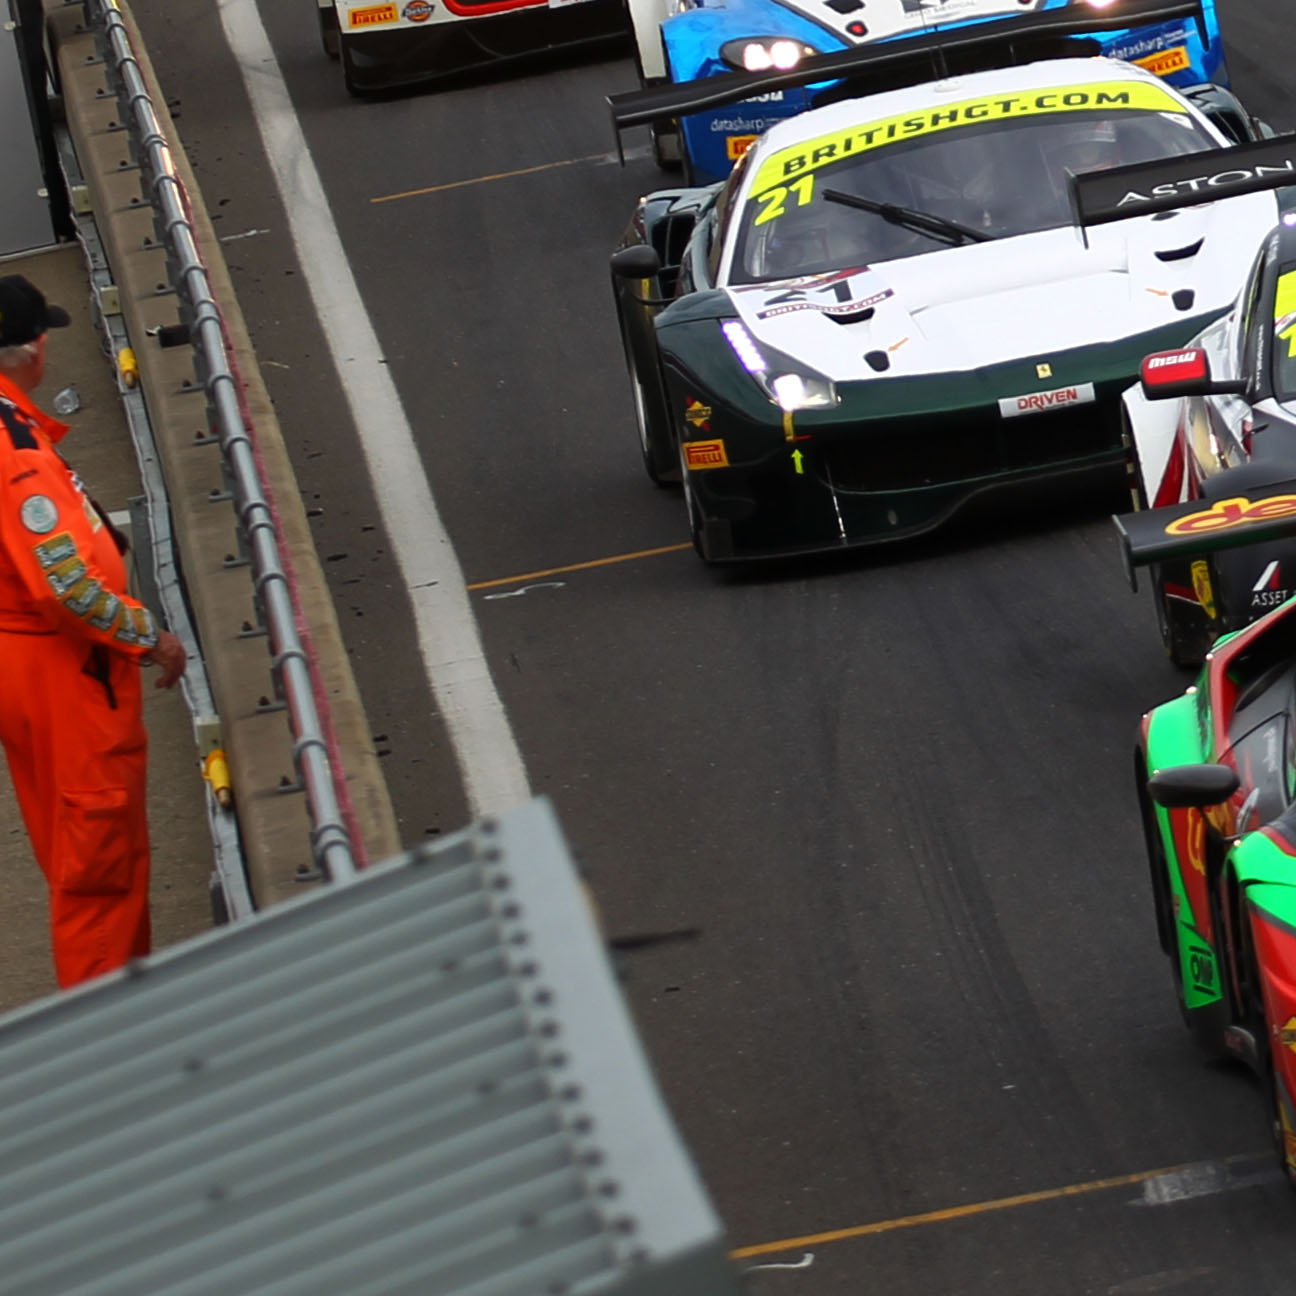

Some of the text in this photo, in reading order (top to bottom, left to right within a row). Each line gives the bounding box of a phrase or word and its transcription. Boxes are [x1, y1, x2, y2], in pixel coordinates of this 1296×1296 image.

[781, 90, 1131, 177] BRITISHGT.COM
[754, 174, 816, 227] 21
[1116, 160, 1293, 208] ASTON
[1016, 386, 1079, 411] DRIVEN
[686, 442, 726, 466] PIRELLI
[1251, 590, 1288, 606] ASSET
